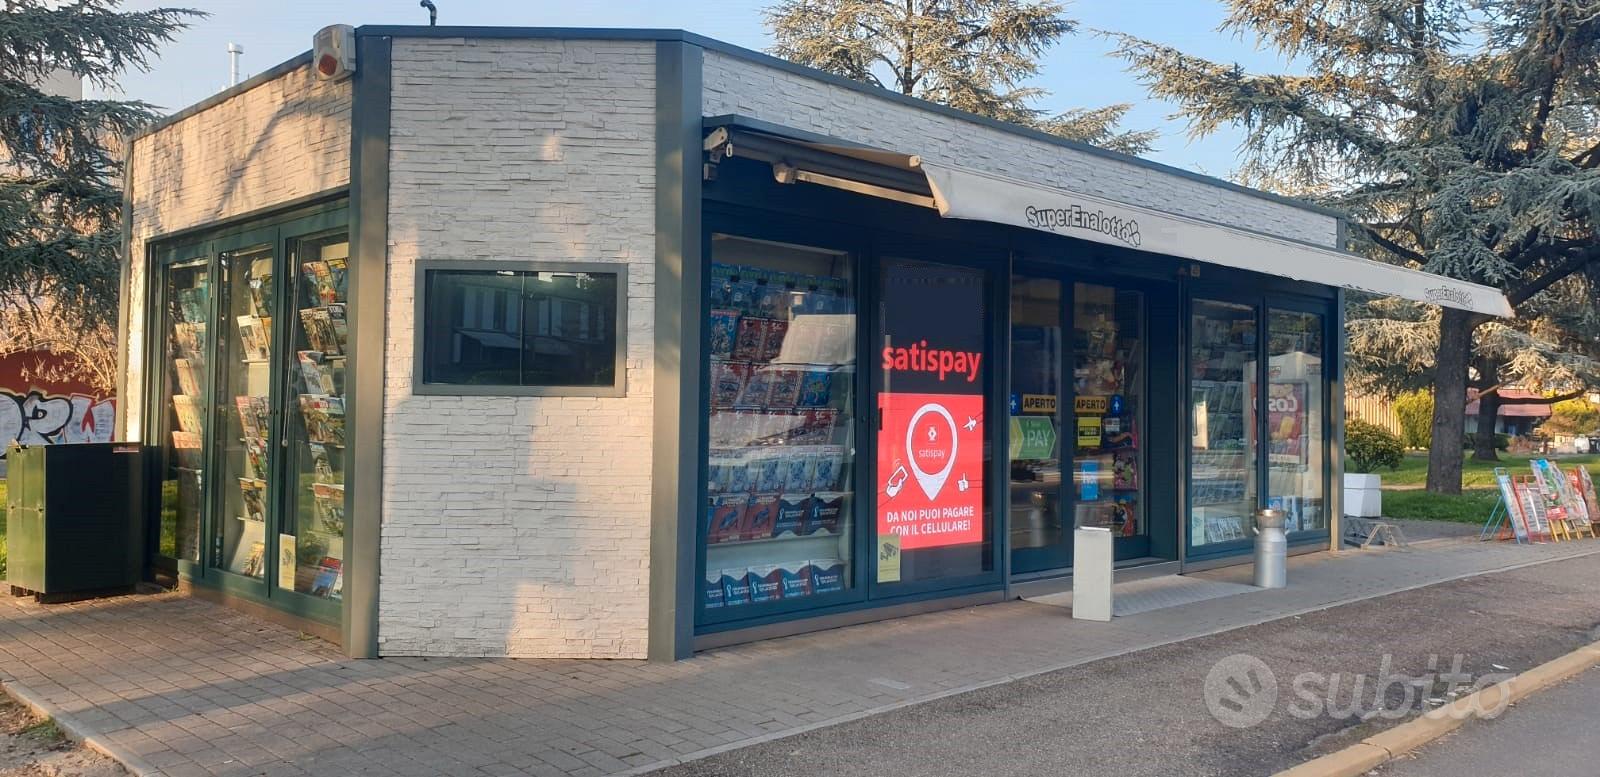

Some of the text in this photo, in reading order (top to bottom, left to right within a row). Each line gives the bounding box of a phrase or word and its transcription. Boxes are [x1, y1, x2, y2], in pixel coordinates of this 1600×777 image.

[1025, 205, 1131, 243] SuperEnalotto
[882, 340, 982, 382] satispay
[1024, 397, 1056, 409] APERTO
[1076, 399, 1106, 410] APERTO
[1027, 430, 1050, 448] PAY
[918, 447, 946, 459] satispay
[887, 506, 975, 523] DA NOI PUOI PAGARE
[890, 520, 971, 537] CON IL CELLULARE!
